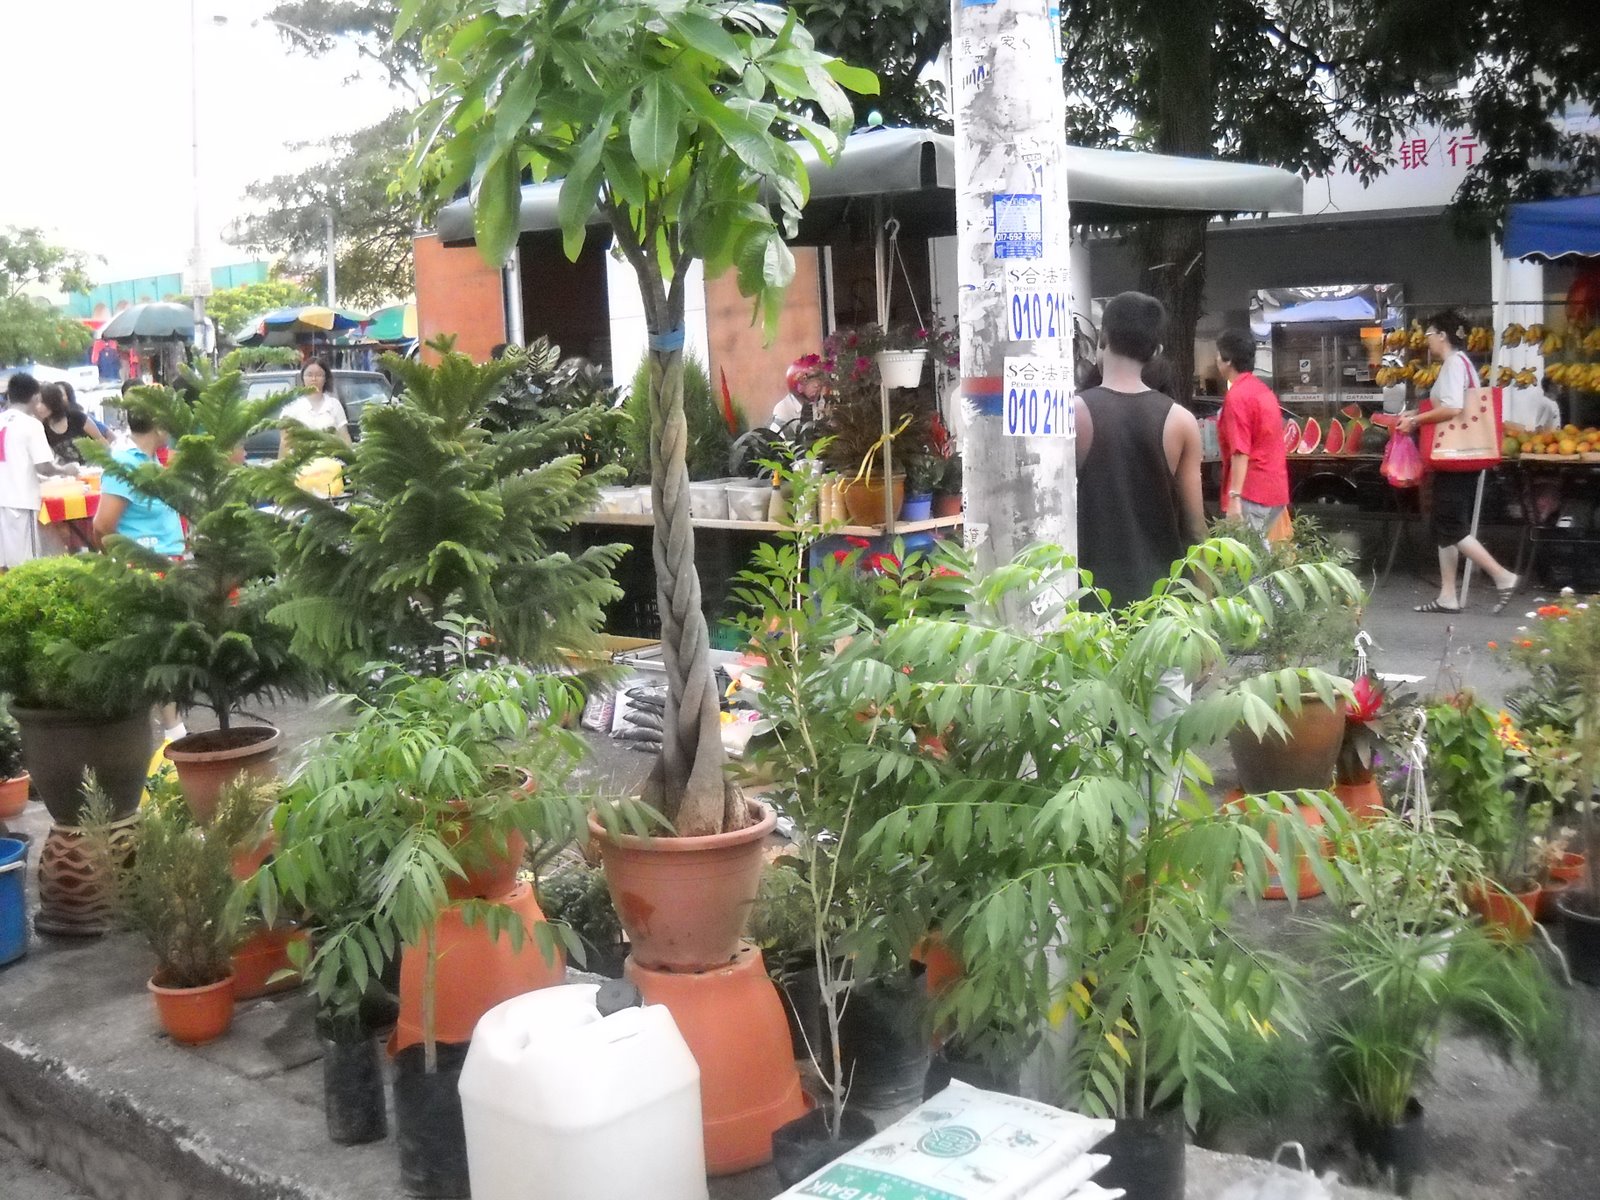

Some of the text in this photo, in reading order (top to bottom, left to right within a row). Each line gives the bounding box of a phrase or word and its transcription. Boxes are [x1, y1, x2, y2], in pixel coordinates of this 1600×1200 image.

[1354, 136, 1478, 172] 银行
[1013, 293, 1041, 340] 010
[1009, 388, 1037, 435] 010
[805, 1180, 860, 1200] BAIK
